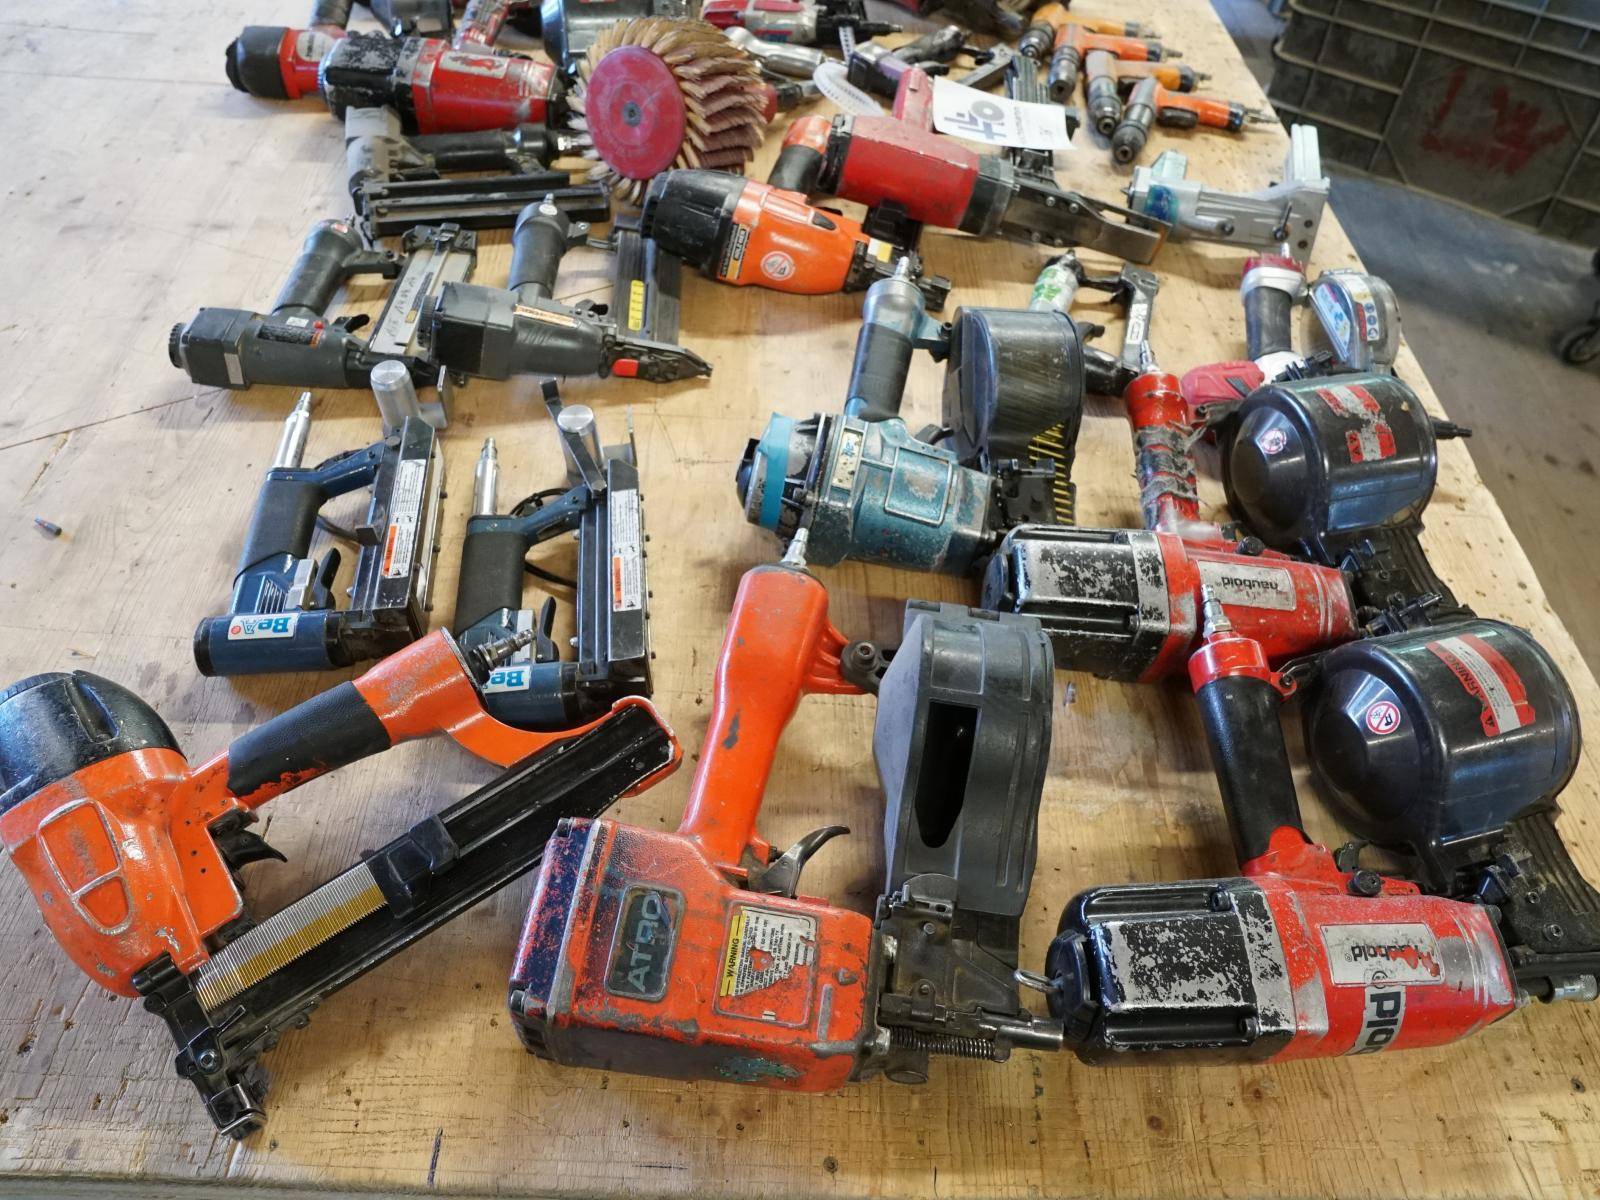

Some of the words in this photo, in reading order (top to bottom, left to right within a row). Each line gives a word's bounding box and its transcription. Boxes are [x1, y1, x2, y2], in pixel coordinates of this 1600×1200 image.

[240, 617, 291, 635] BeA
[484, 671, 524, 689] Be
[627, 891, 662, 993] ATRO
[726, 937, 739, 978] WARNING
[735, 958, 743, 988] INSTRUCTION
